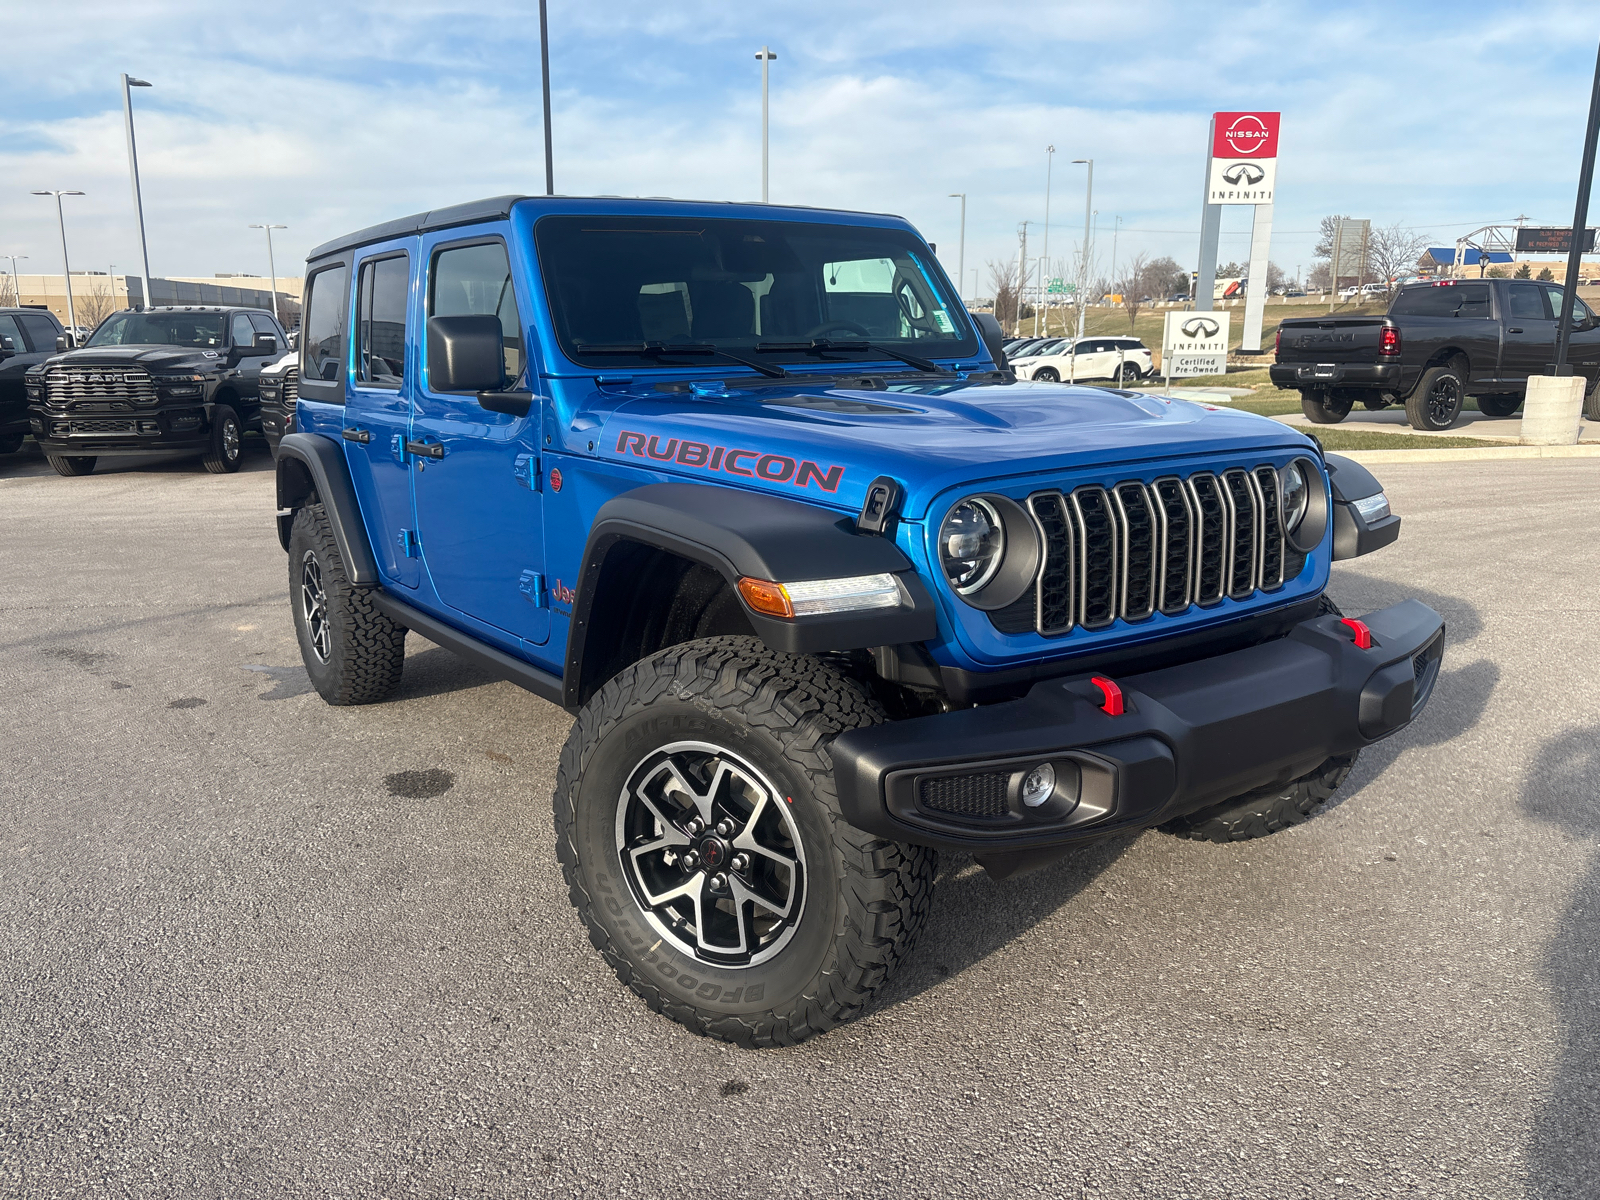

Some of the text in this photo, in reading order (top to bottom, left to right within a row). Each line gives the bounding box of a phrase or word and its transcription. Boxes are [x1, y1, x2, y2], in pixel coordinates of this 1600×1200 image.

[1212, 191, 1272, 199] INFINITI
[1300, 333, 1355, 343] RAM
[1180, 358, 1216, 366] Certified
[1175, 366, 1219, 374] Pre-Owned
[69, 374, 123, 383] RAM
[615, 430, 846, 494] RUBICON
[552, 578, 576, 605] Jee
